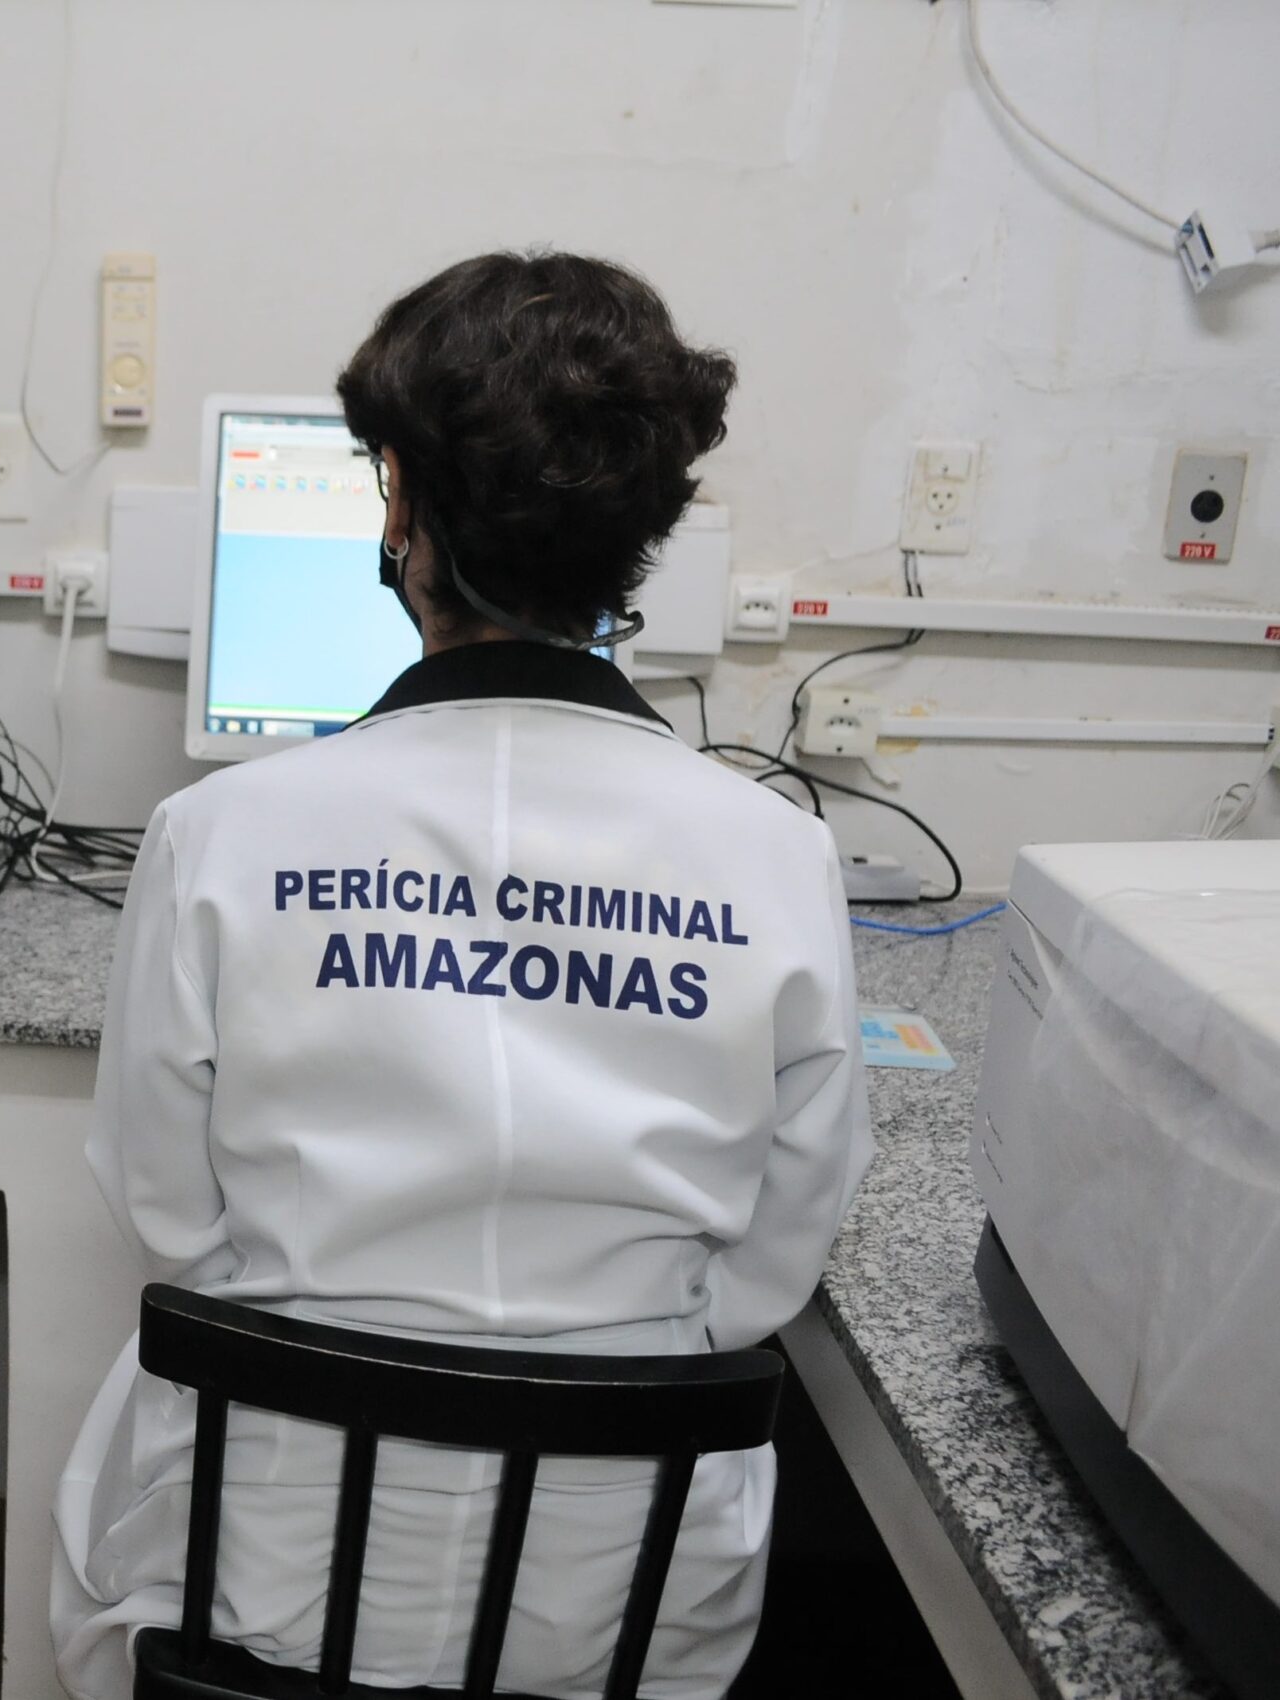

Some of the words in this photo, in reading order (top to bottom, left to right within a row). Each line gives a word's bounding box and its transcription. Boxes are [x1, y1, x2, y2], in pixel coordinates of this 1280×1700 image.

[1184, 544, 1202, 558] 220
[1204, 545, 1213, 558] V
[275, 858, 477, 918] PERÍCIA
[495, 873, 749, 946] CRIMINAL
[315, 932, 708, 1019] AMAZONAS
